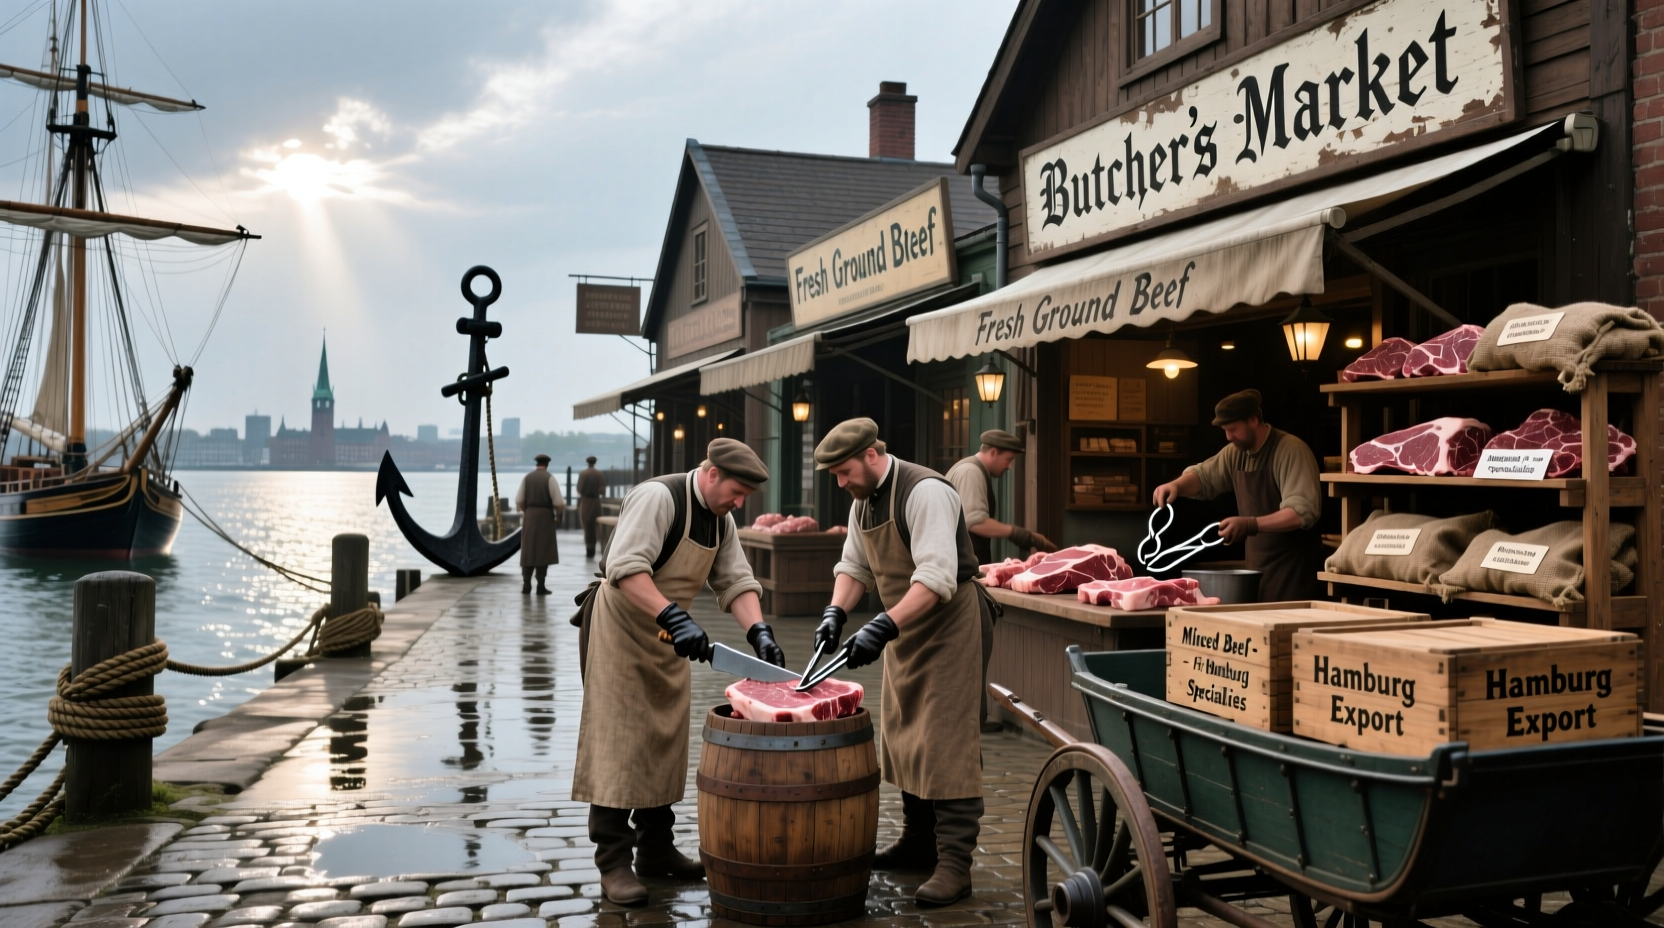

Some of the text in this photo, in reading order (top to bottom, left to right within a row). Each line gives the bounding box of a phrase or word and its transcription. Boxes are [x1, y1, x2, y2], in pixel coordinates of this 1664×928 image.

[1039, 8, 1459, 232] Butcher's Market
[795, 256, 829, 305] Fresh
[832, 230, 887, 289] Ground
[975, 261, 1196, 346] Fresh Ground Beef
[1313, 654, 1416, 708] Hamburg
[1485, 664, 1612, 700] Hamburg
[1330, 694, 1405, 736] Export
[1506, 703, 1597, 742] Export
